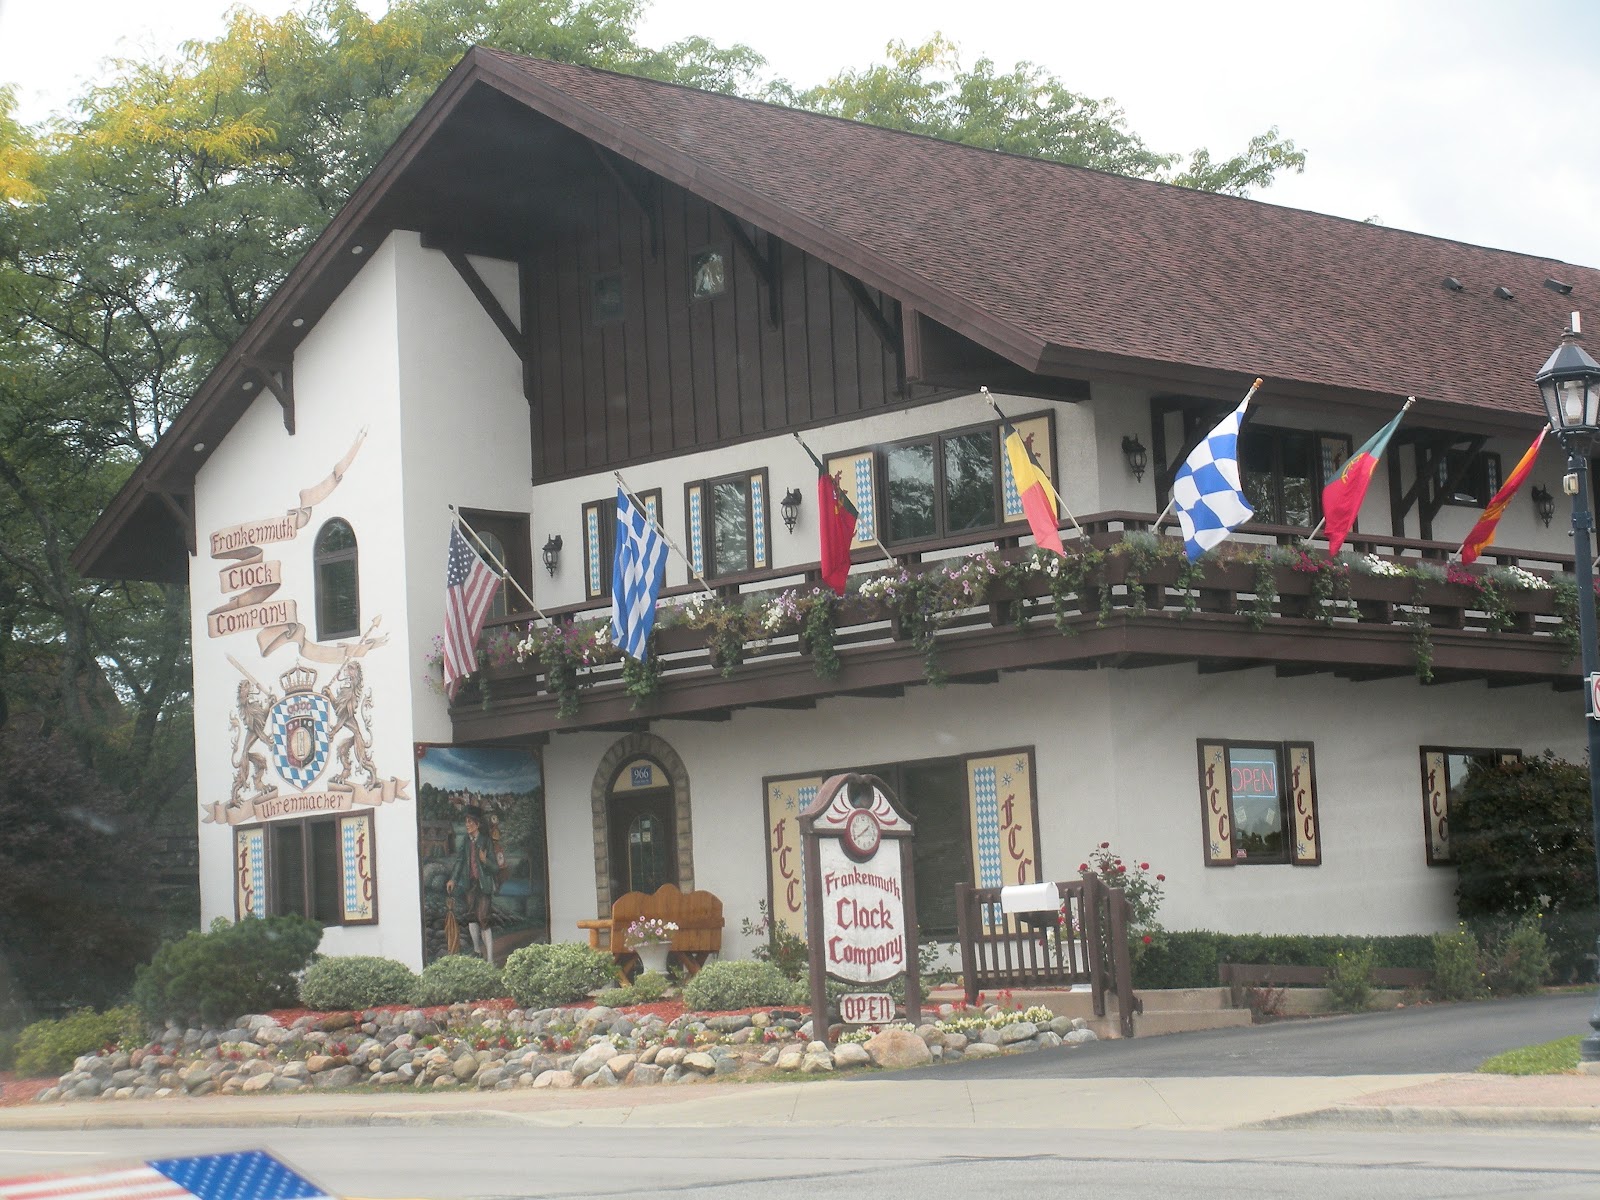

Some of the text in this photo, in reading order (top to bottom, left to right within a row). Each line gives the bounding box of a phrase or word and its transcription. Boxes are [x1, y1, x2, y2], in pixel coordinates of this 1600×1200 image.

[211, 517, 294, 553] Frankenmuth
[228, 563, 273, 590] Clock
[215, 601, 288, 635] Company
[634, 767, 649, 780] 966
[1231, 767, 1274, 792] OPEN
[261, 792, 345, 818] Uhrenmacher
[825, 866, 901, 901] Frankenmuth
[836, 897, 894, 930] Clock
[828, 935, 903, 975] Company
[844, 993, 892, 1021] OPEN
